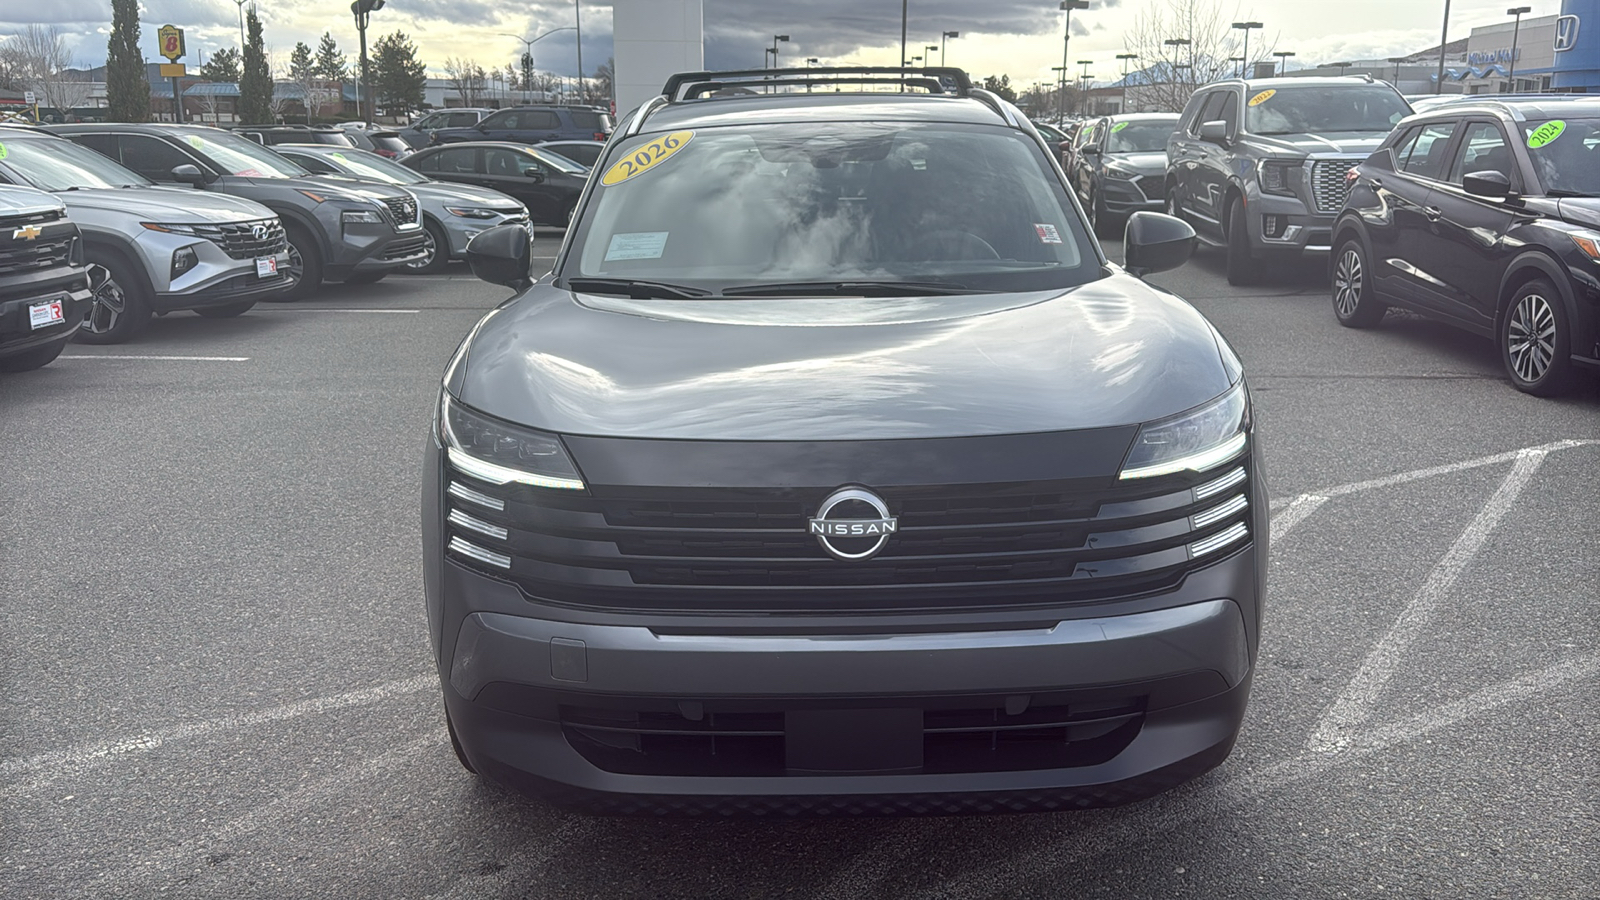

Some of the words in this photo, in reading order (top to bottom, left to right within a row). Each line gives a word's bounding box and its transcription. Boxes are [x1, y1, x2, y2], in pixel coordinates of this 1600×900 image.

[165, 36, 178, 52] 8
[1532, 123, 1559, 145] 2024
[619, 134, 680, 177] 2026
[811, 521, 895, 535] NISSAN
